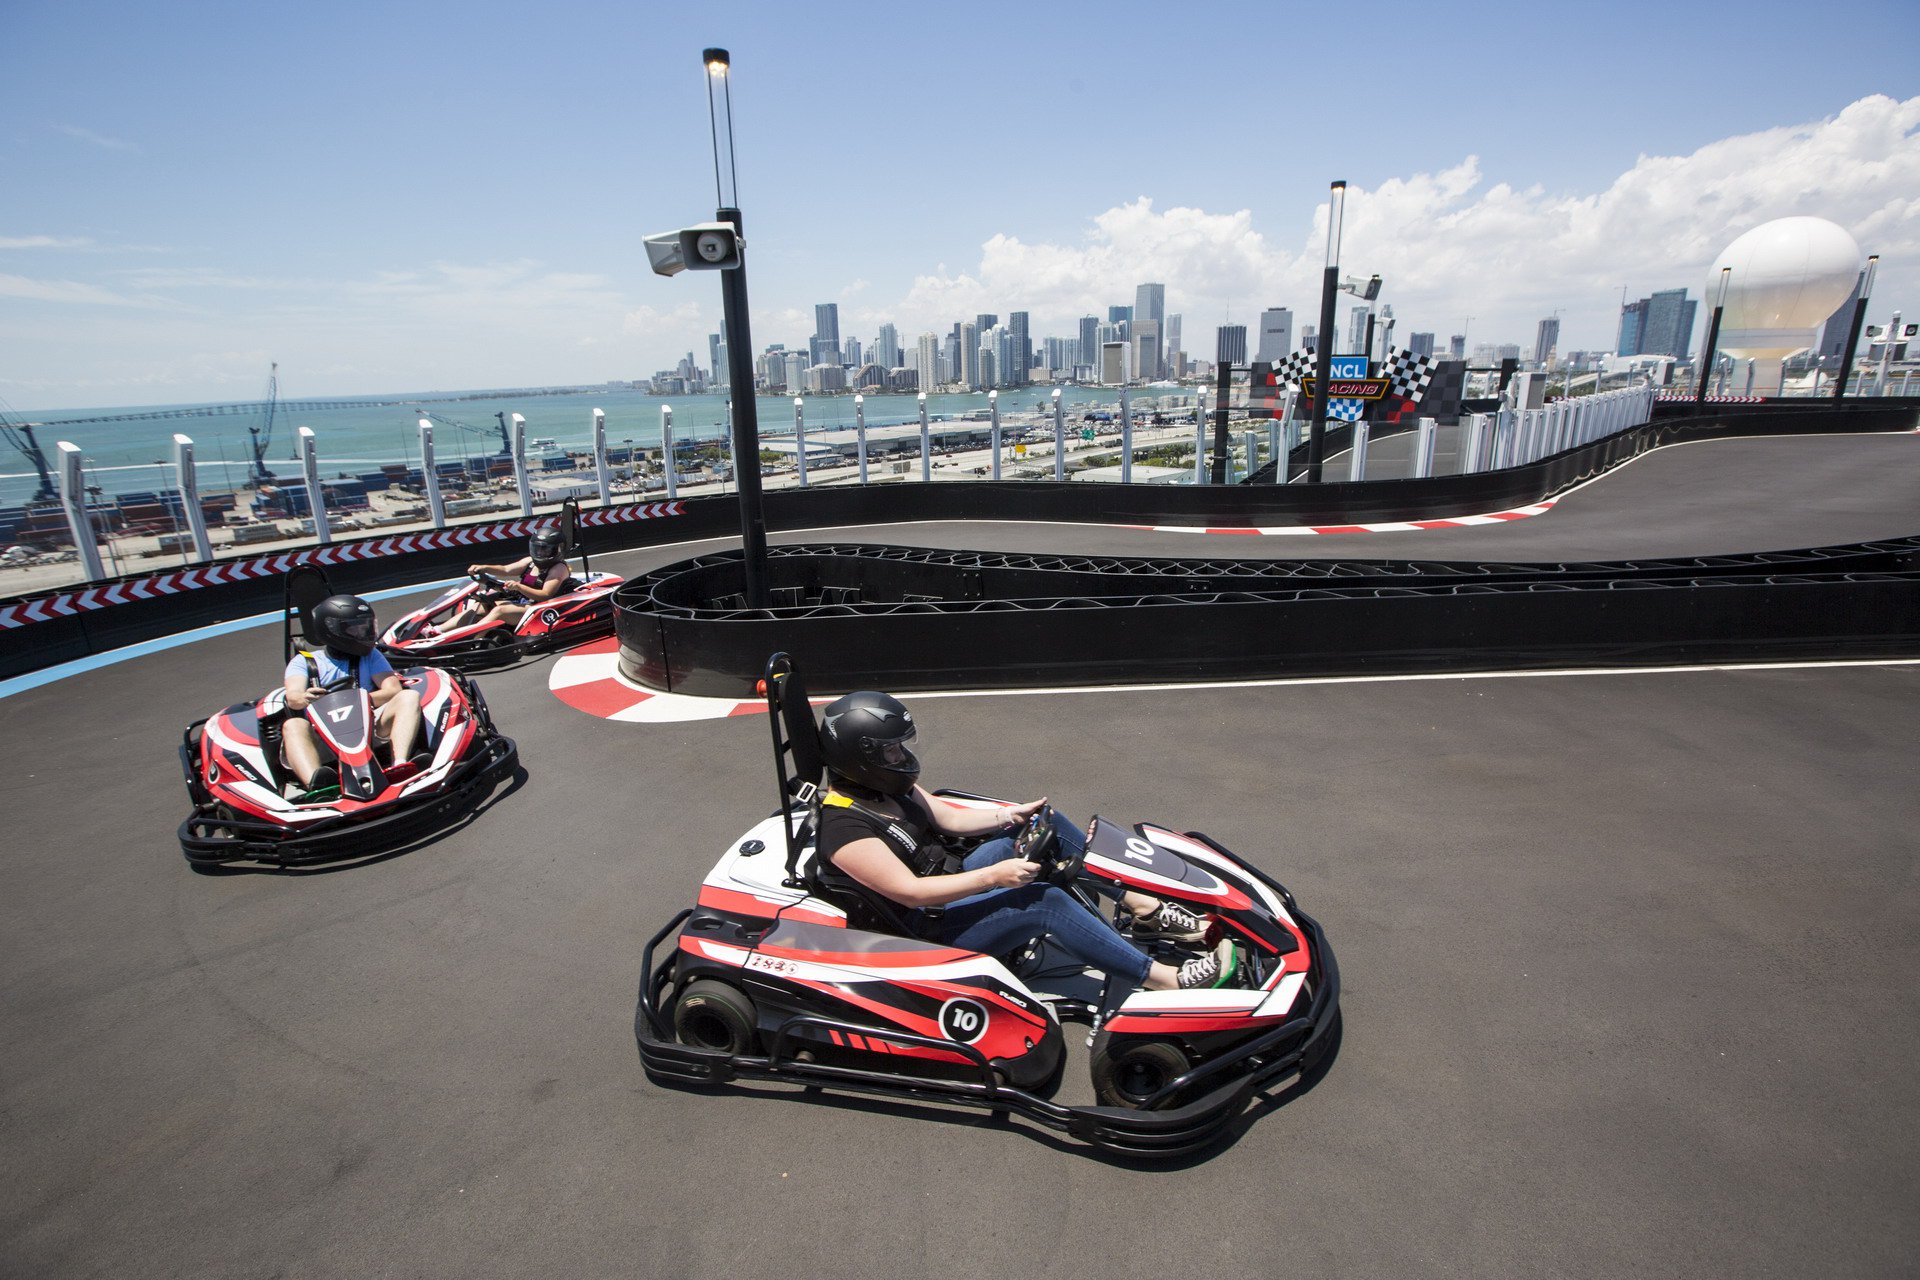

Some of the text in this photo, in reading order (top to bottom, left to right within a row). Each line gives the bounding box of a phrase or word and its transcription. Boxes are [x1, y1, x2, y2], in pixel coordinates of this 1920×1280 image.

[1330, 364, 1364, 378] NCL
[1328, 384, 1379, 394] ACING
[327, 705, 354, 723] 17
[1124, 838, 1153, 865] 10
[952, 1008, 978, 1031] 10
